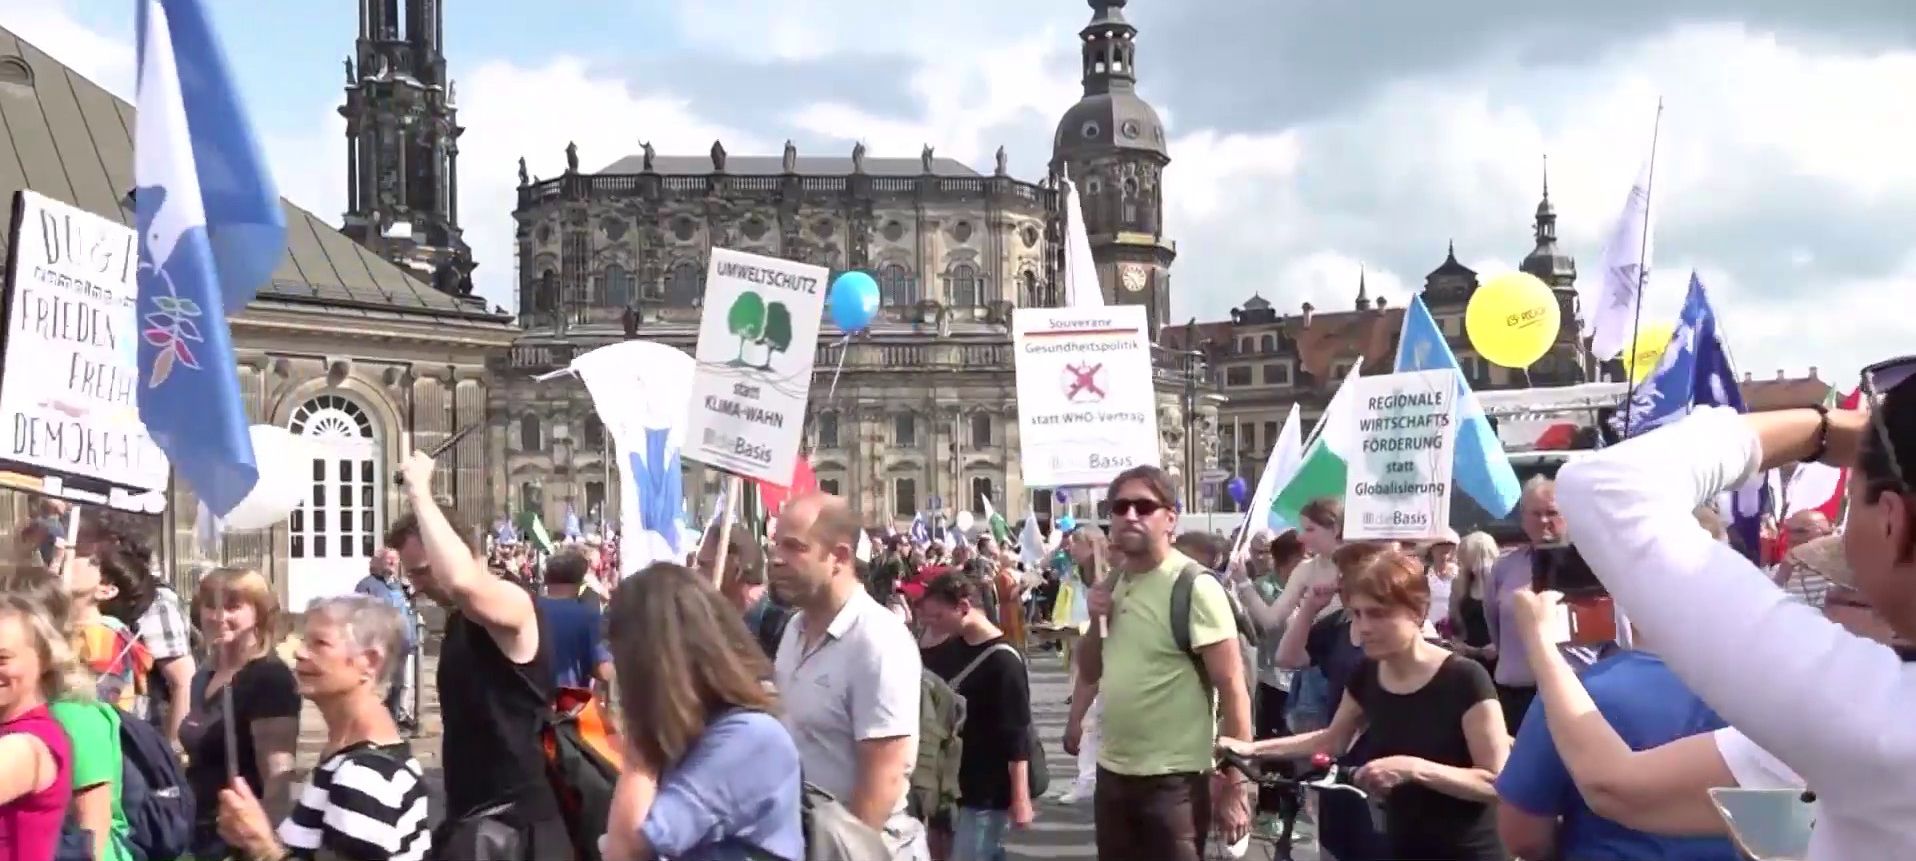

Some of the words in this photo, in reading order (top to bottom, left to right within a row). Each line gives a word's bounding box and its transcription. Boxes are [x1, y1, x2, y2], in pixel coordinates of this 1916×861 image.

[717, 261, 817, 295] UMWELTSCHUTZ
[21, 288, 116, 351] FRIEDEN
[1025, 339, 1139, 354] Gesundheitspolitik
[733, 382, 761, 399] statt
[1368, 391, 1442, 411] REGIONALE
[704, 394, 784, 429] KLIMA-WAHN
[1031, 415, 1060, 425] statt
[1360, 413, 1449, 432] WIRTSCHAFTS
[1386, 460, 1414, 473] statt
[1355, 482, 1445, 497] Globalisierung
